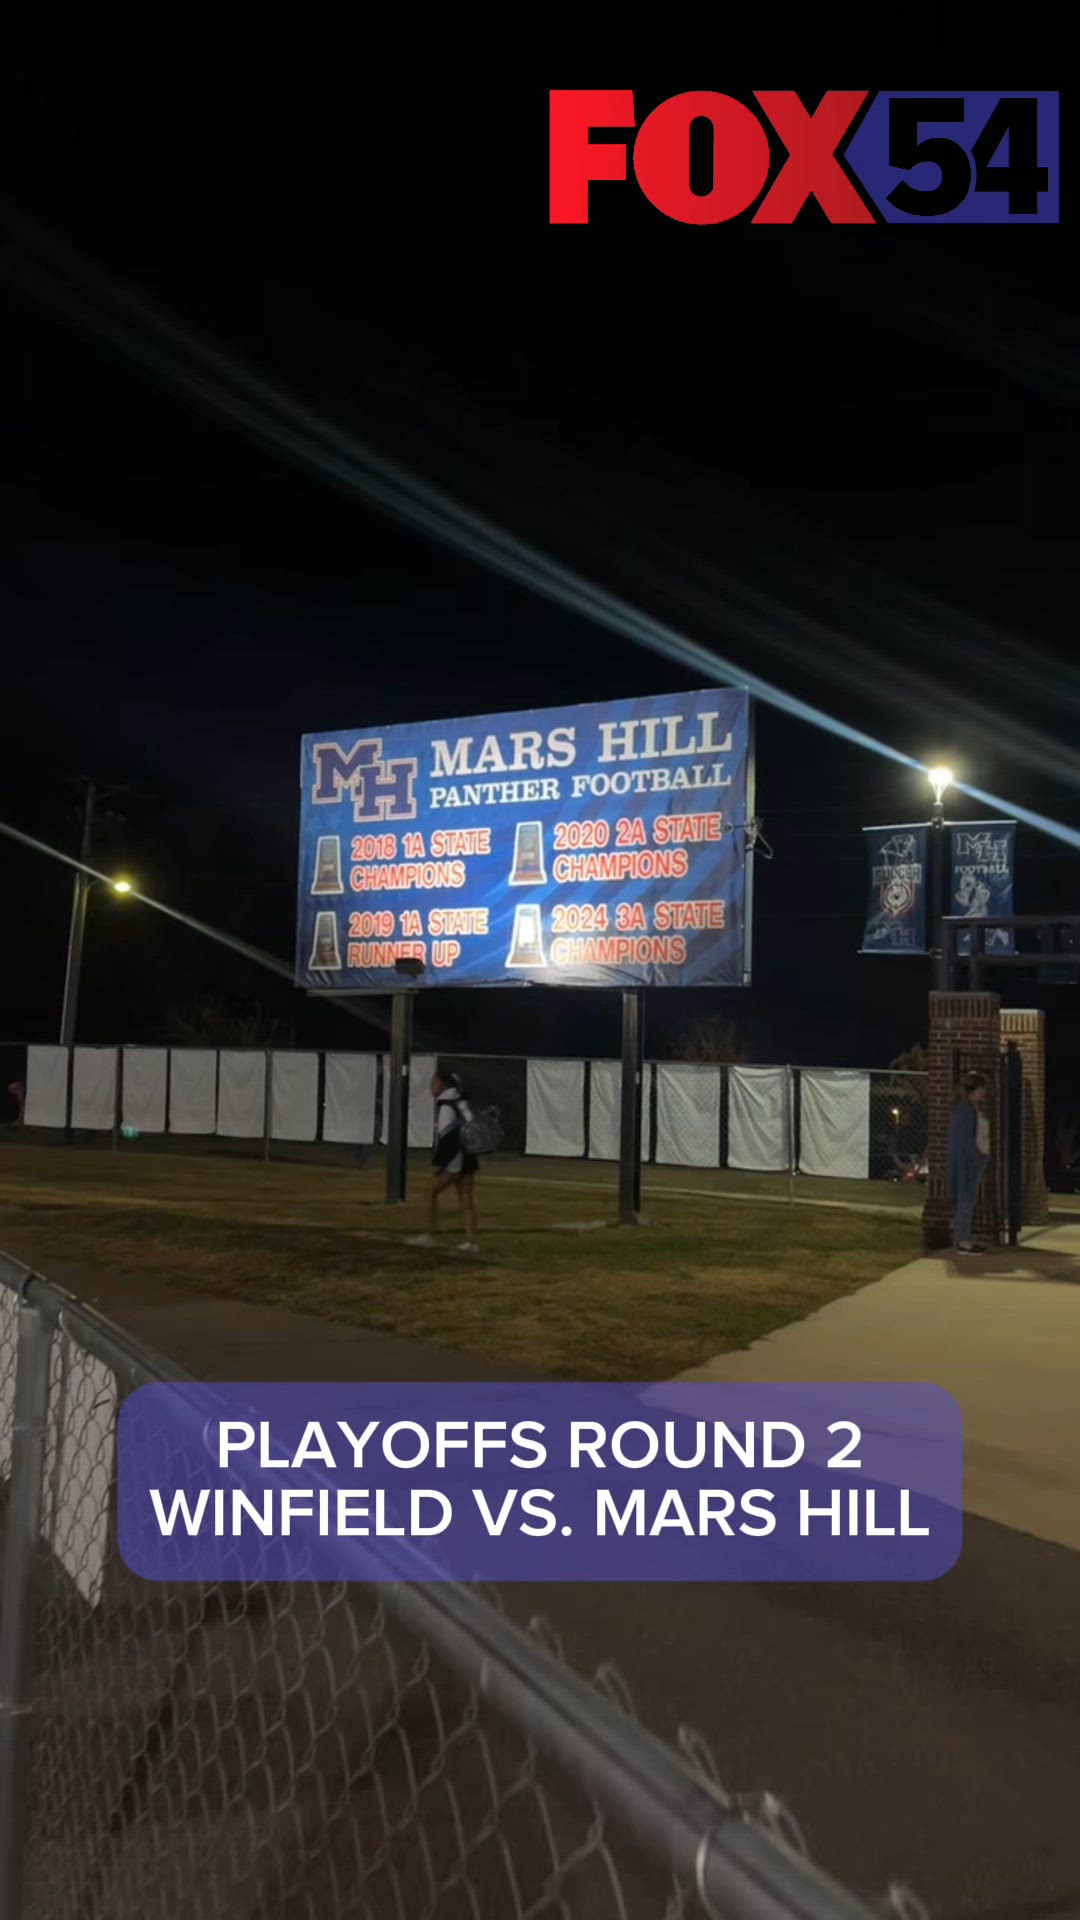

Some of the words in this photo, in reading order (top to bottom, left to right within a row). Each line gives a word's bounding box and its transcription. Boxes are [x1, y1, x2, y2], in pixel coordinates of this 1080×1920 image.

[430, 727, 576, 777] MARS
[598, 711, 733, 763] HILL
[312, 738, 417, 822] MH
[430, 777, 560, 808] PANTHER
[571, 763, 731, 798] FOOTBALL
[351, 834, 396, 861] 2018
[402, 832, 425, 856] 1A
[431, 828, 491, 855] STATE
[554, 819, 609, 850] 2020
[615, 818, 646, 846] 2A
[653, 812, 722, 845] STATE
[351, 860, 465, 892] CHAMPIONS
[553, 849, 688, 883] CHAMPIONS
[349, 911, 394, 937] 2019
[400, 910, 422, 935] 1A
[428, 908, 489, 935] STATE
[552, 904, 608, 932] 2024
[615, 902, 646, 930] 3A
[654, 900, 724, 930] STATE
[431, 941, 460, 967] UP
[551, 935, 686, 965] CHAMPIONS
